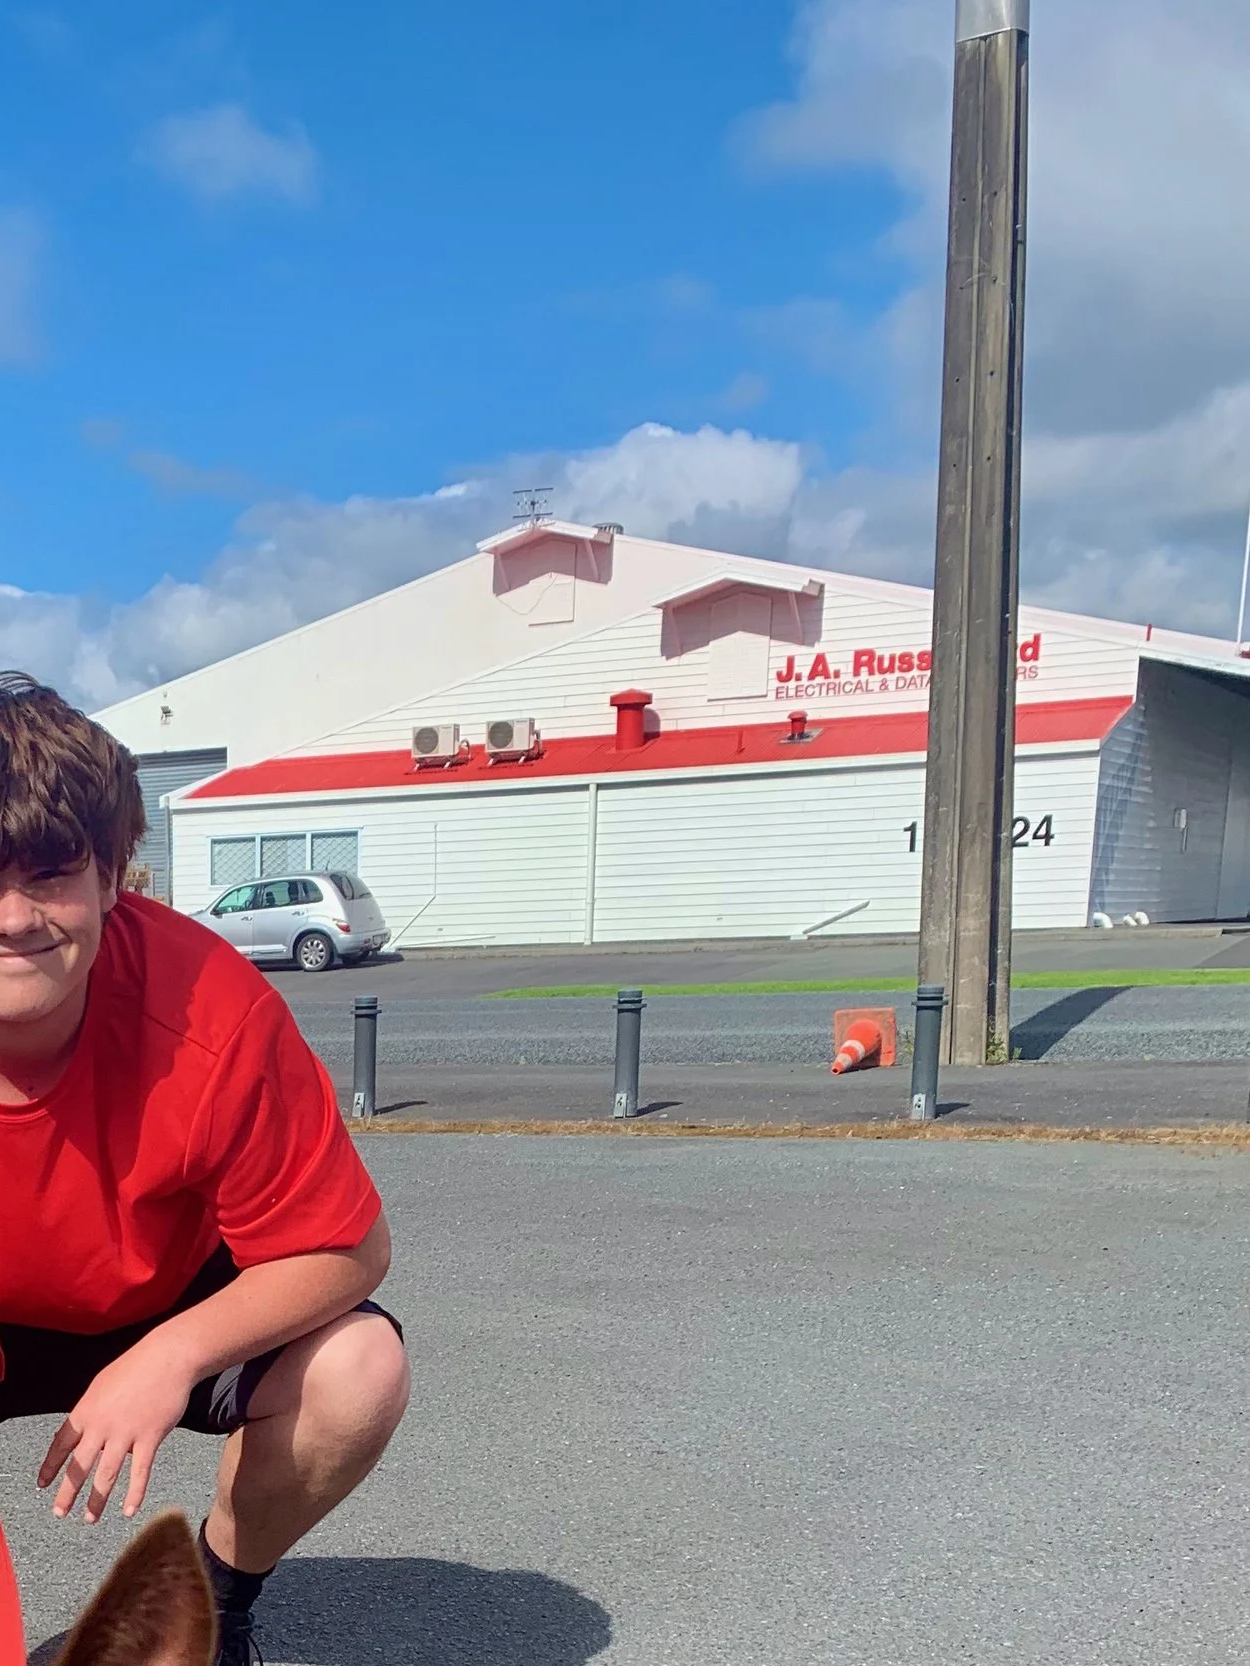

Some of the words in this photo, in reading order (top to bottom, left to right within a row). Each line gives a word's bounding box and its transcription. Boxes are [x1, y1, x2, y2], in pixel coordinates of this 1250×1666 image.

[776, 655, 802, 683] J.
[807, 653, 840, 680] A.
[853, 649, 931, 678] Russ
[775, 680, 874, 699] ELECTRICAL
[879, 676, 890, 691] &
